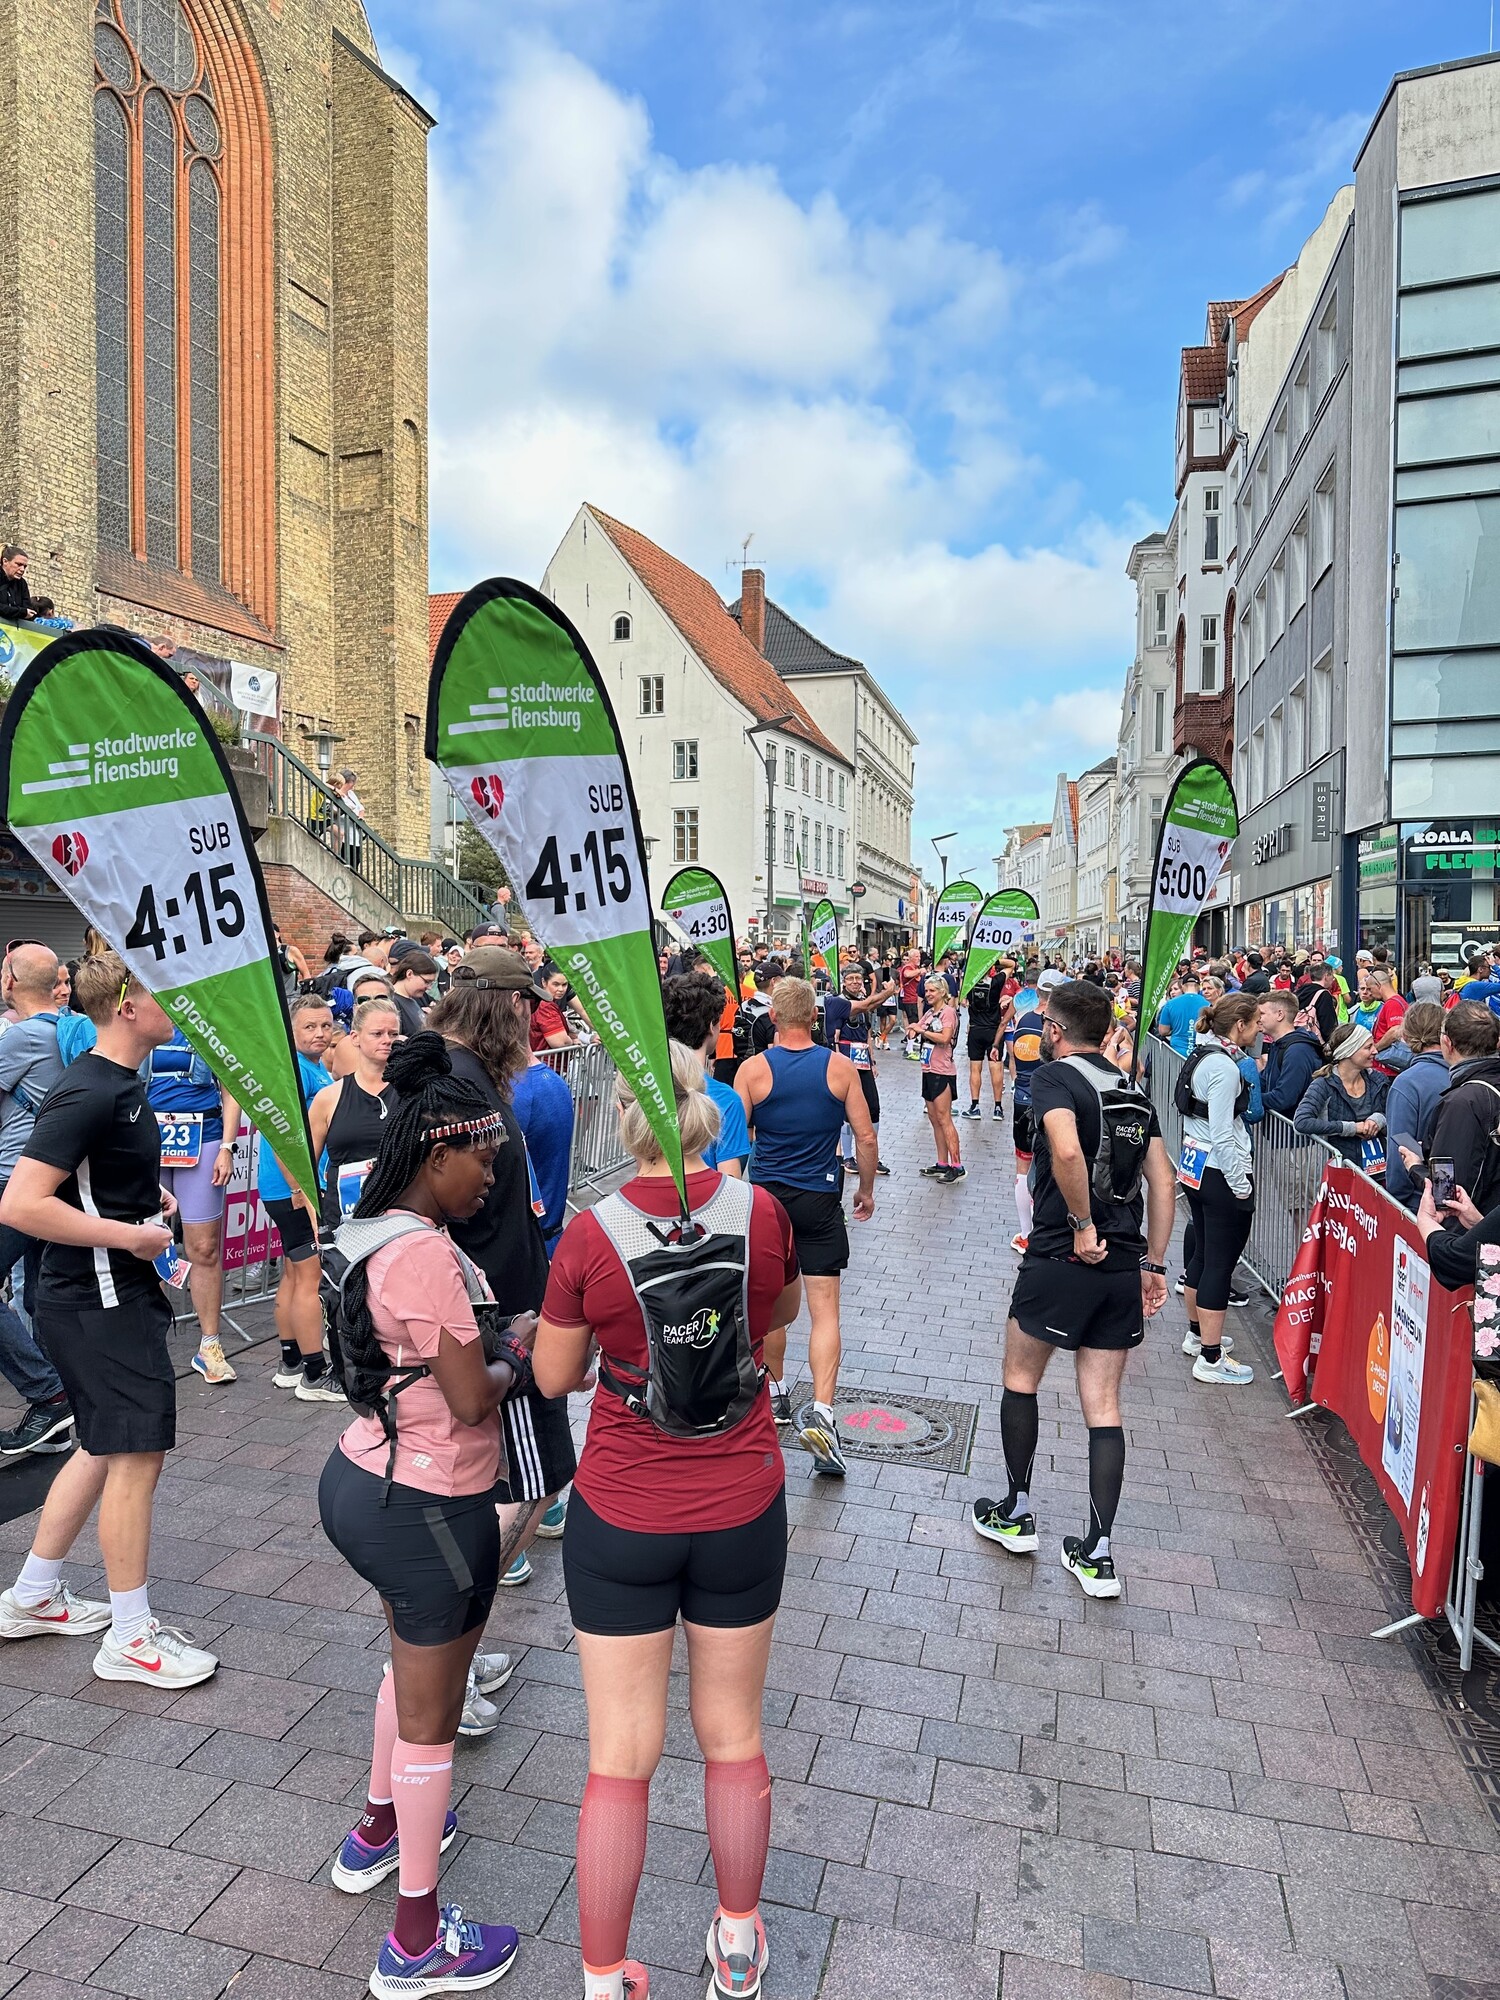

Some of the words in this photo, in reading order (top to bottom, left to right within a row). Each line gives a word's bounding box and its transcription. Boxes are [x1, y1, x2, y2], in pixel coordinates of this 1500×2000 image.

[511, 681, 594, 703] stadtwerke
[511, 705, 581, 733] flensburg
[94, 728, 197, 758] stadtwerke
[94, 756, 178, 785] flensburg
[588, 784, 623, 813] SUB
[1199, 810, 1226, 828] flensburg
[189, 821, 231, 855] SUB
[1167, 836, 1180, 853] SUB
[1414, 831, 1472, 843] KOALA
[526, 827, 632, 915] 4:15
[1160, 857, 1207, 900] 5:00
[126, 862, 245, 961] 4:15
[710, 904, 723, 912] SUB
[938, 912, 965, 922] 4:45
[690, 913, 727, 937] 4:30
[819, 928, 836, 949] 5:00
[976, 928, 1012, 944] 4:00
[1151, 958, 1175, 1007] glasfaser
[568, 952, 629, 1040] glasfaser
[625, 1041, 647, 1070] ist
[169, 994, 242, 1073] glasfaser
[239, 1070, 264, 1098] ist
[254, 1094, 291, 1135] grün
[162, 1126, 190, 1146] 23
[1116, 1125, 1136, 1133] PACER
[161, 1149, 187, 1157] riam
[232, 1169, 253, 1181] Wi
[1284, 1271, 1317, 1288] oppelherz
[663, 1320, 700, 1337] PACER
[663, 1334, 695, 1344] TEAM.de
[403, 1776, 431, 1785] cep
